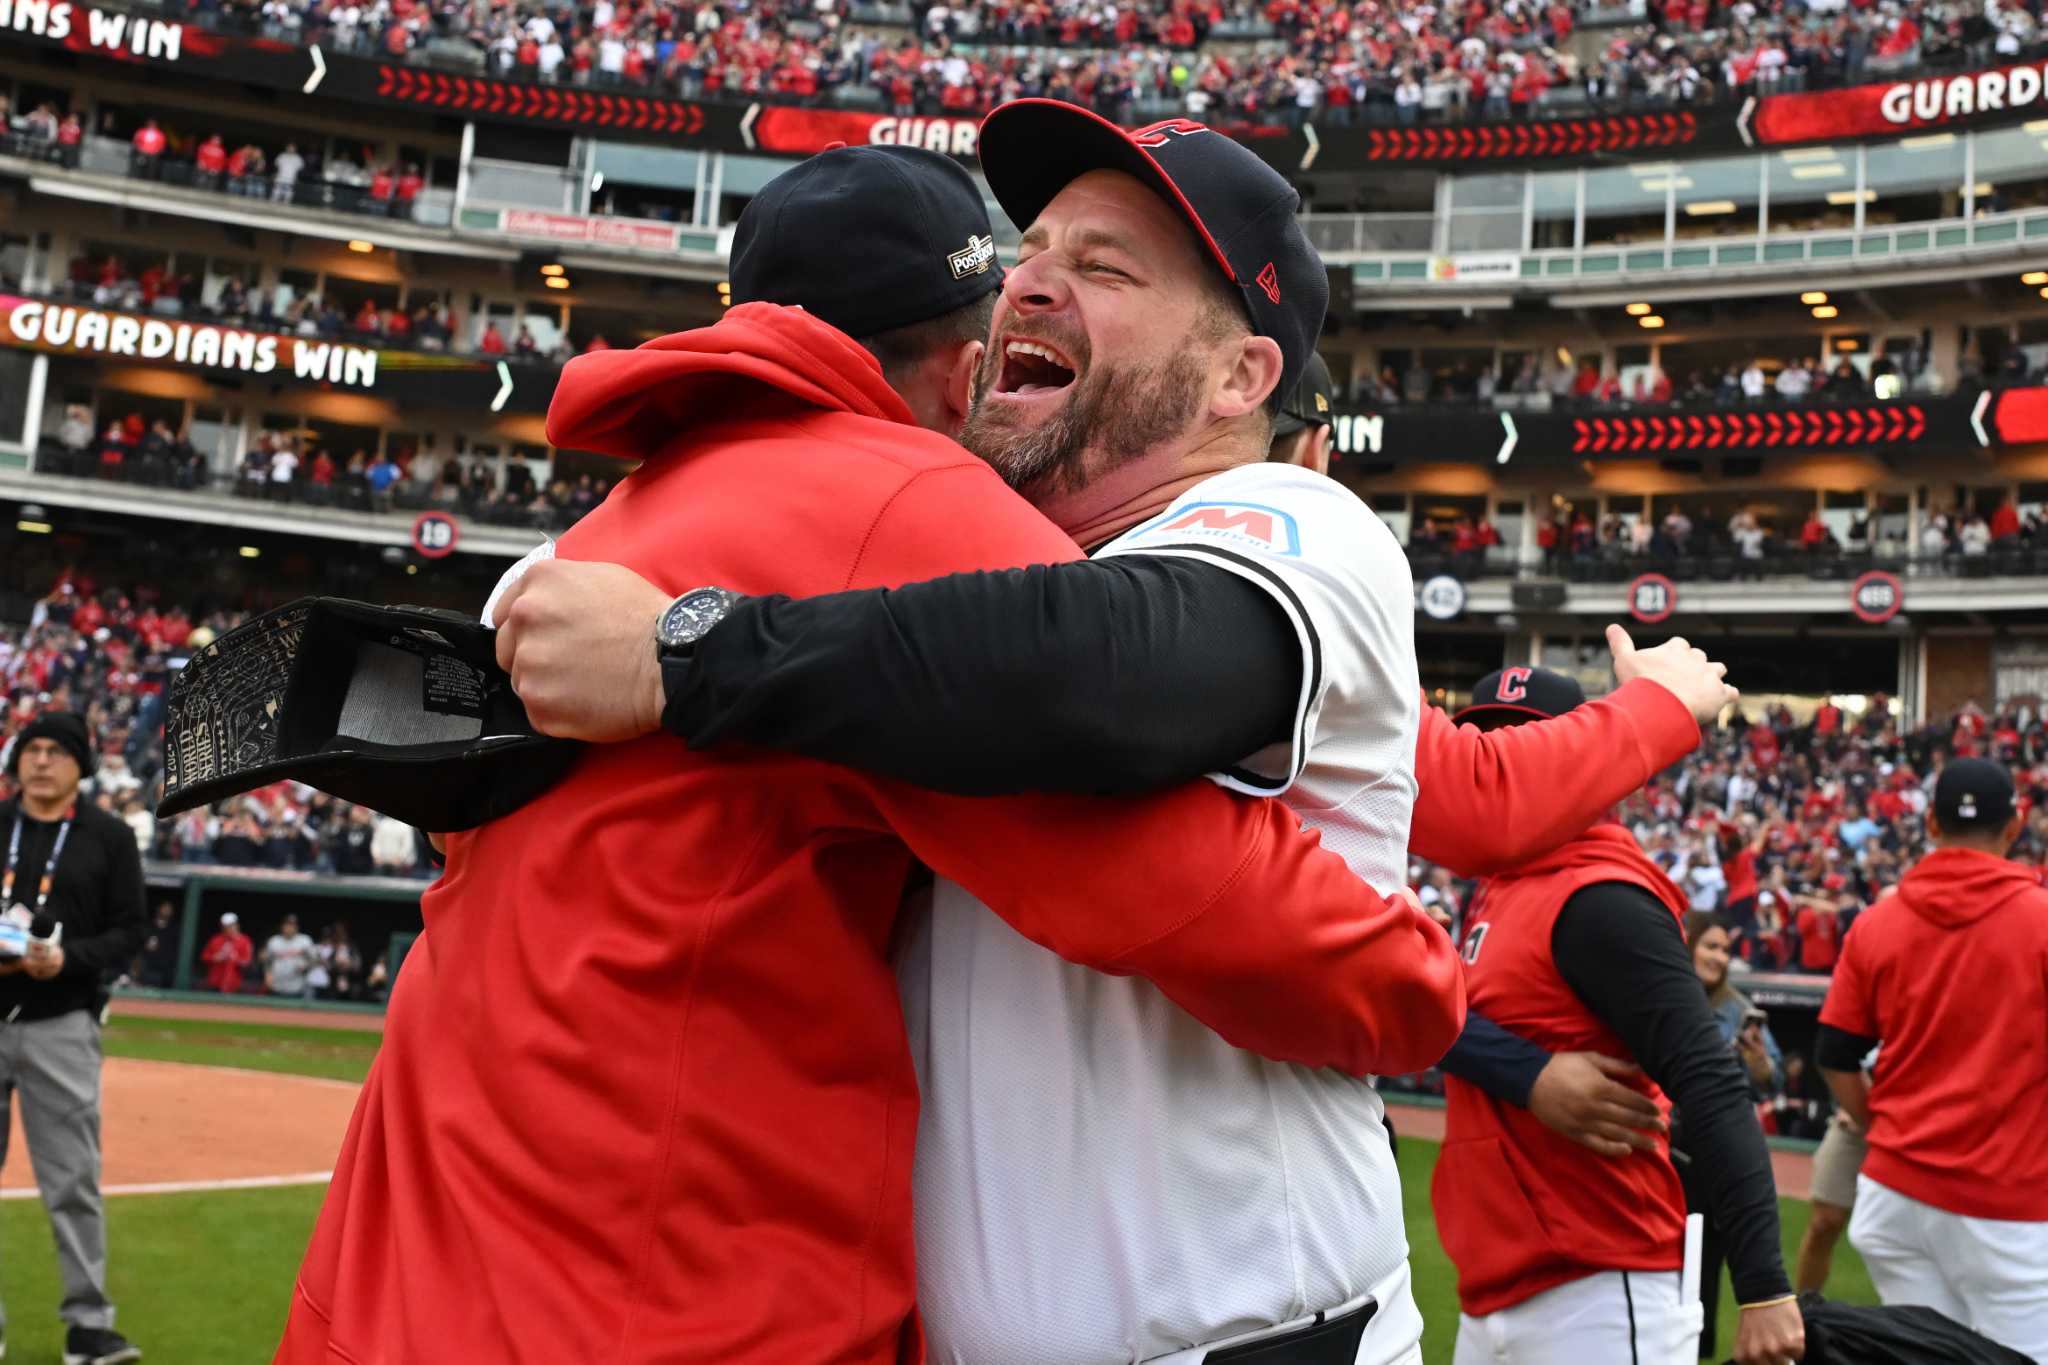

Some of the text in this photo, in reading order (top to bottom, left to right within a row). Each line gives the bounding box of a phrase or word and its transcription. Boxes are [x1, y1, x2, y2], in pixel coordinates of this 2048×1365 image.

[0, 0, 183, 61] NS WIN
[1880, 63, 2048, 124] GUARD
[9, 302, 378, 388] GUARDIANS WIN
[1328, 414, 1384, 453] IN
[1496, 665, 1533, 702] C
